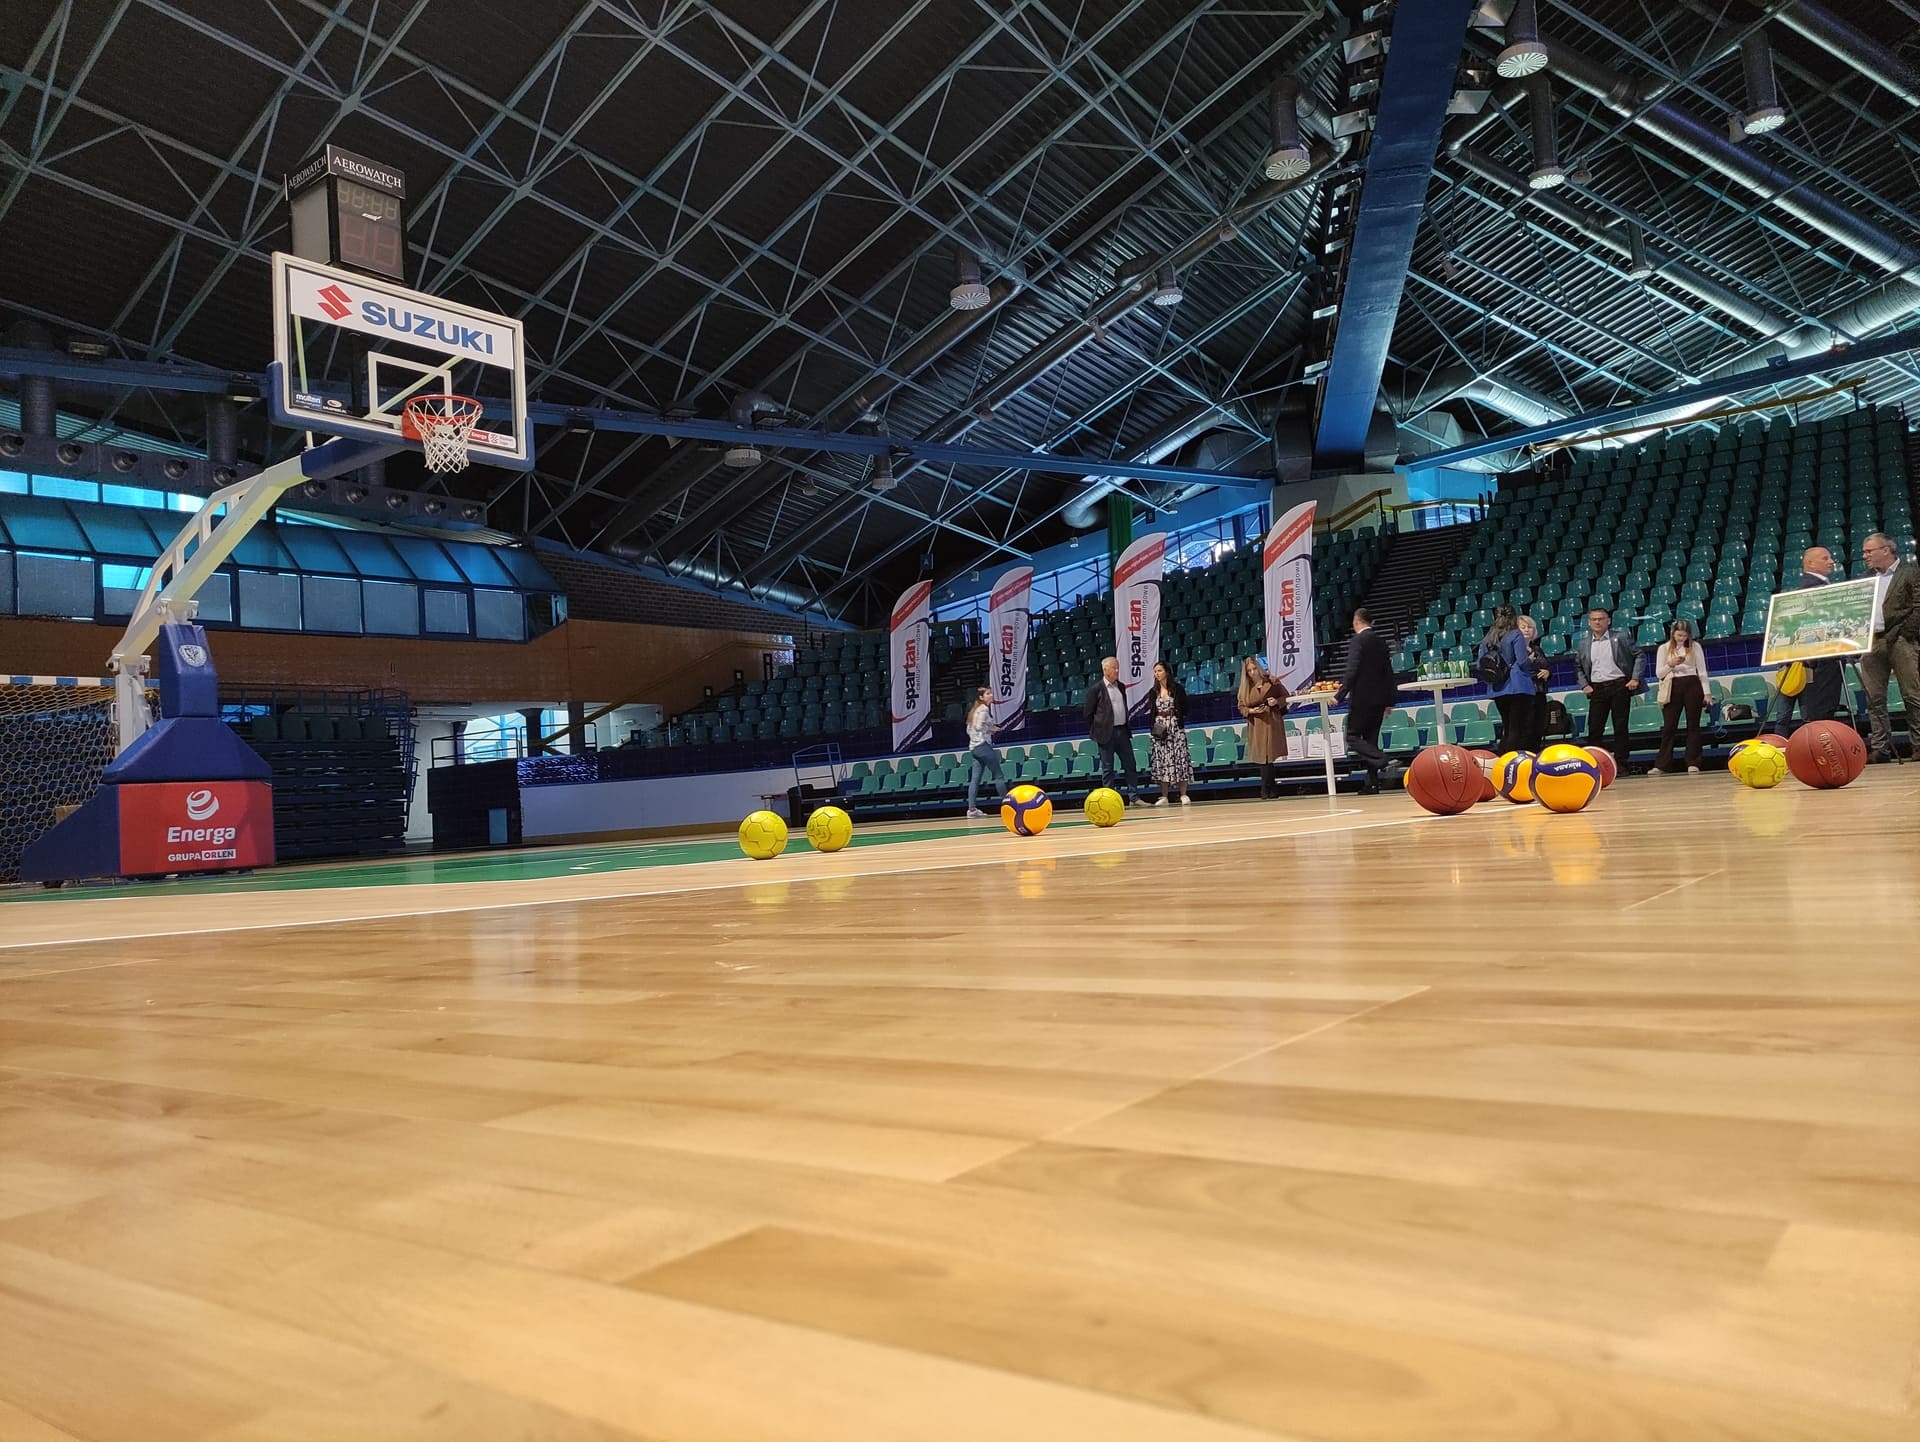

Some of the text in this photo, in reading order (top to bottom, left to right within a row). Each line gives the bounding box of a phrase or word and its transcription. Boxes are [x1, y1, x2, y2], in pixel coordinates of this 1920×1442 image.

[288, 154, 327, 189] AEROWATCH
[333, 155, 402, 188] AEROWATCH
[361, 301, 494, 354] SUZUKI
[1128, 598, 1145, 678] spartan
[1279, 579, 1300, 668] spartan
[903, 638, 920, 710] spartan
[1000, 624, 1015, 697] spartan
[167, 826, 236, 845] Energa
[167, 850, 234, 862] GRUPA ORLEN
